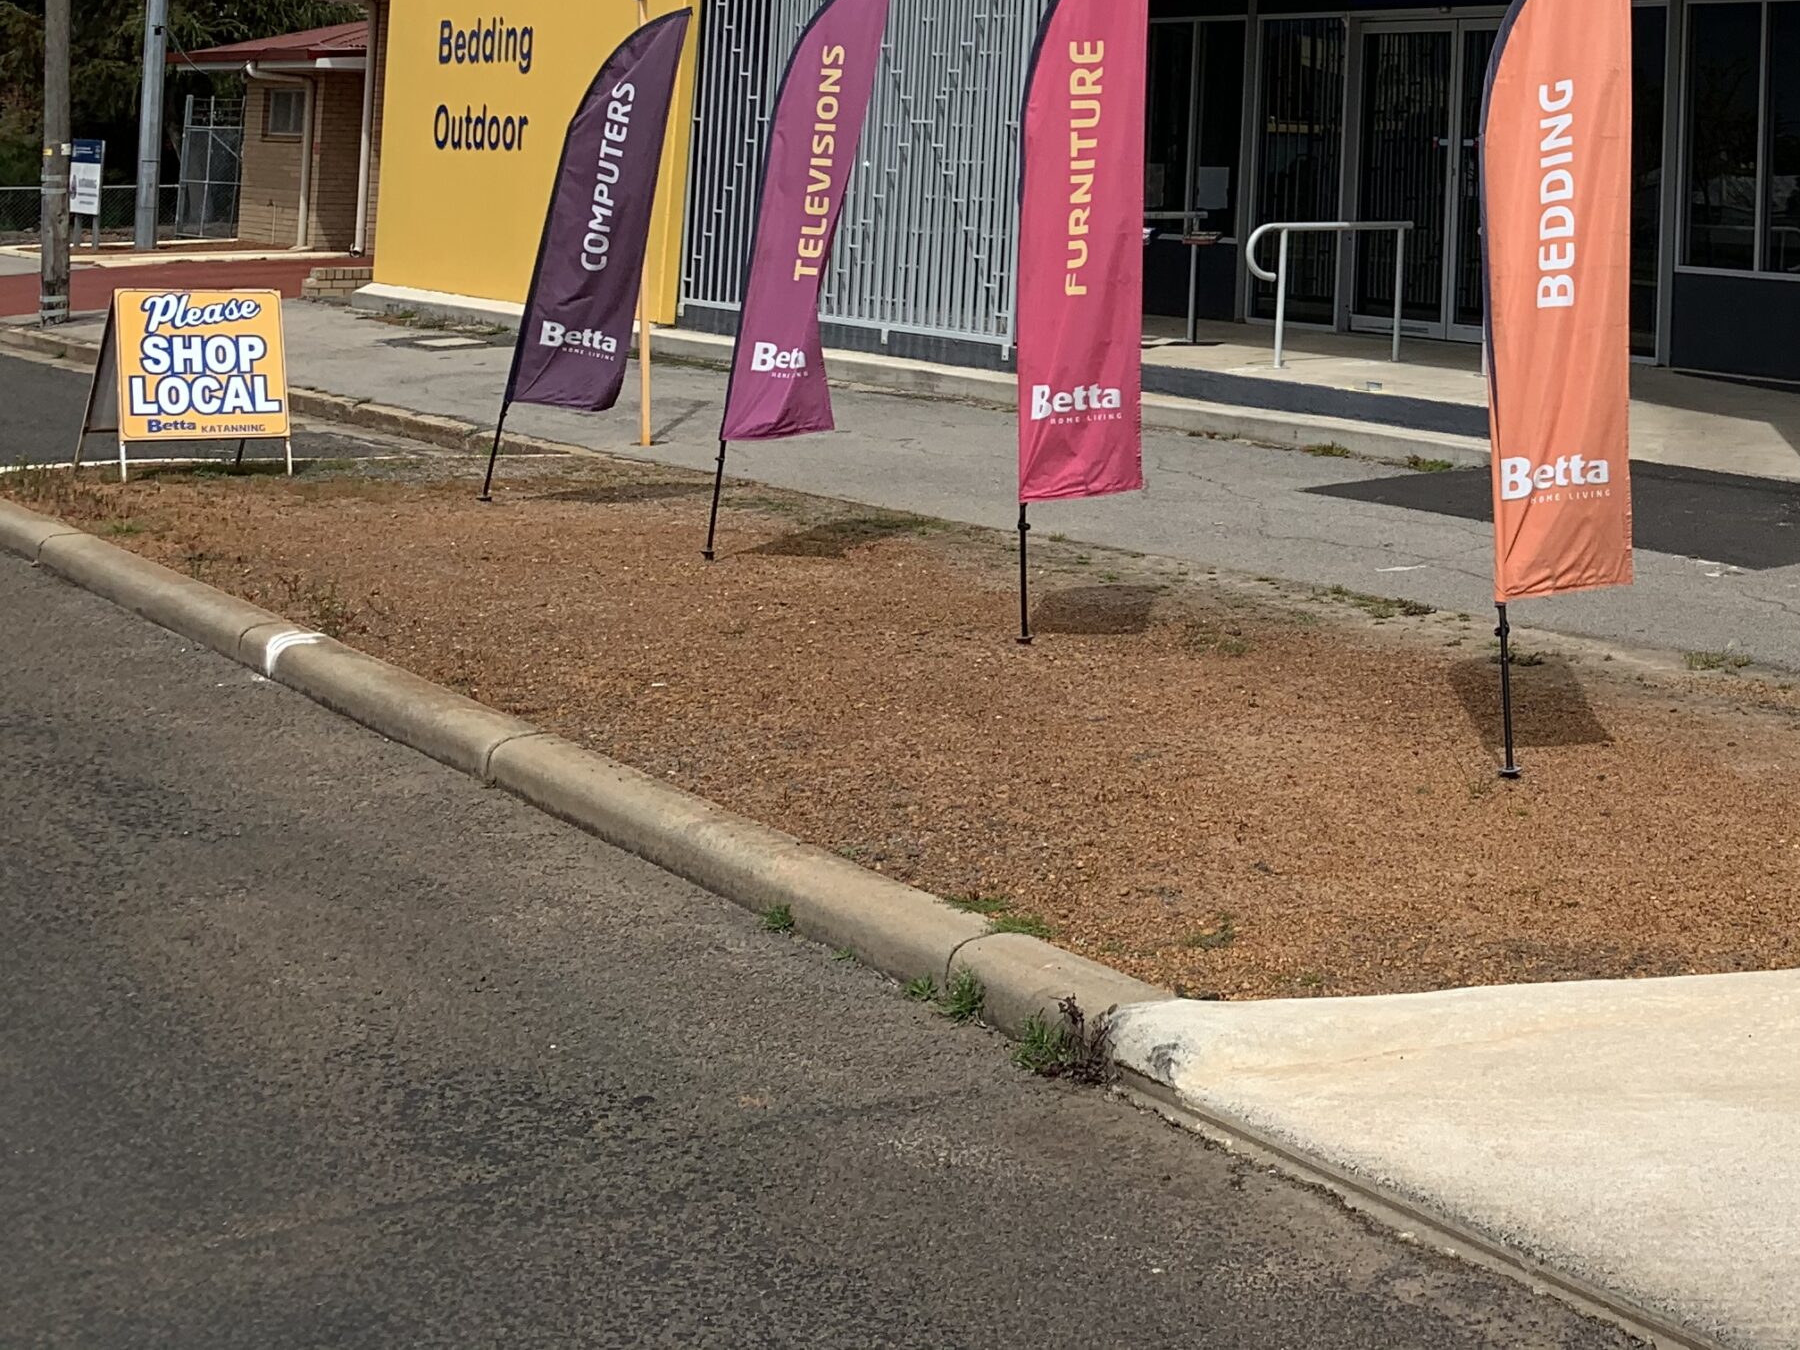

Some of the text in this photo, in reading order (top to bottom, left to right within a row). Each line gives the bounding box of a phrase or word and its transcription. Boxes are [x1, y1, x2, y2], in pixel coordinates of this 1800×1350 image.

[438, 17, 534, 75] Bedding
[434, 104, 529, 151] Outdoor
[581, 81, 636, 272] COMPUTERS
[793, 44, 845, 282] TELEVISIONS
[1065, 39, 1105, 297] FURNITURE
[1536, 78, 1575, 310] BEDDING
[141, 292, 262, 334] Please
[140, 334, 267, 375] SHOP
[539, 320, 617, 353] Betta
[129, 375, 283, 416] LOCAL
[1031, 384, 1120, 420] Betta
[147, 419, 266, 434] Betta KATANNING
[1500, 454, 1609, 501] Betta
[1568, 489, 1611, 500] LIVING
